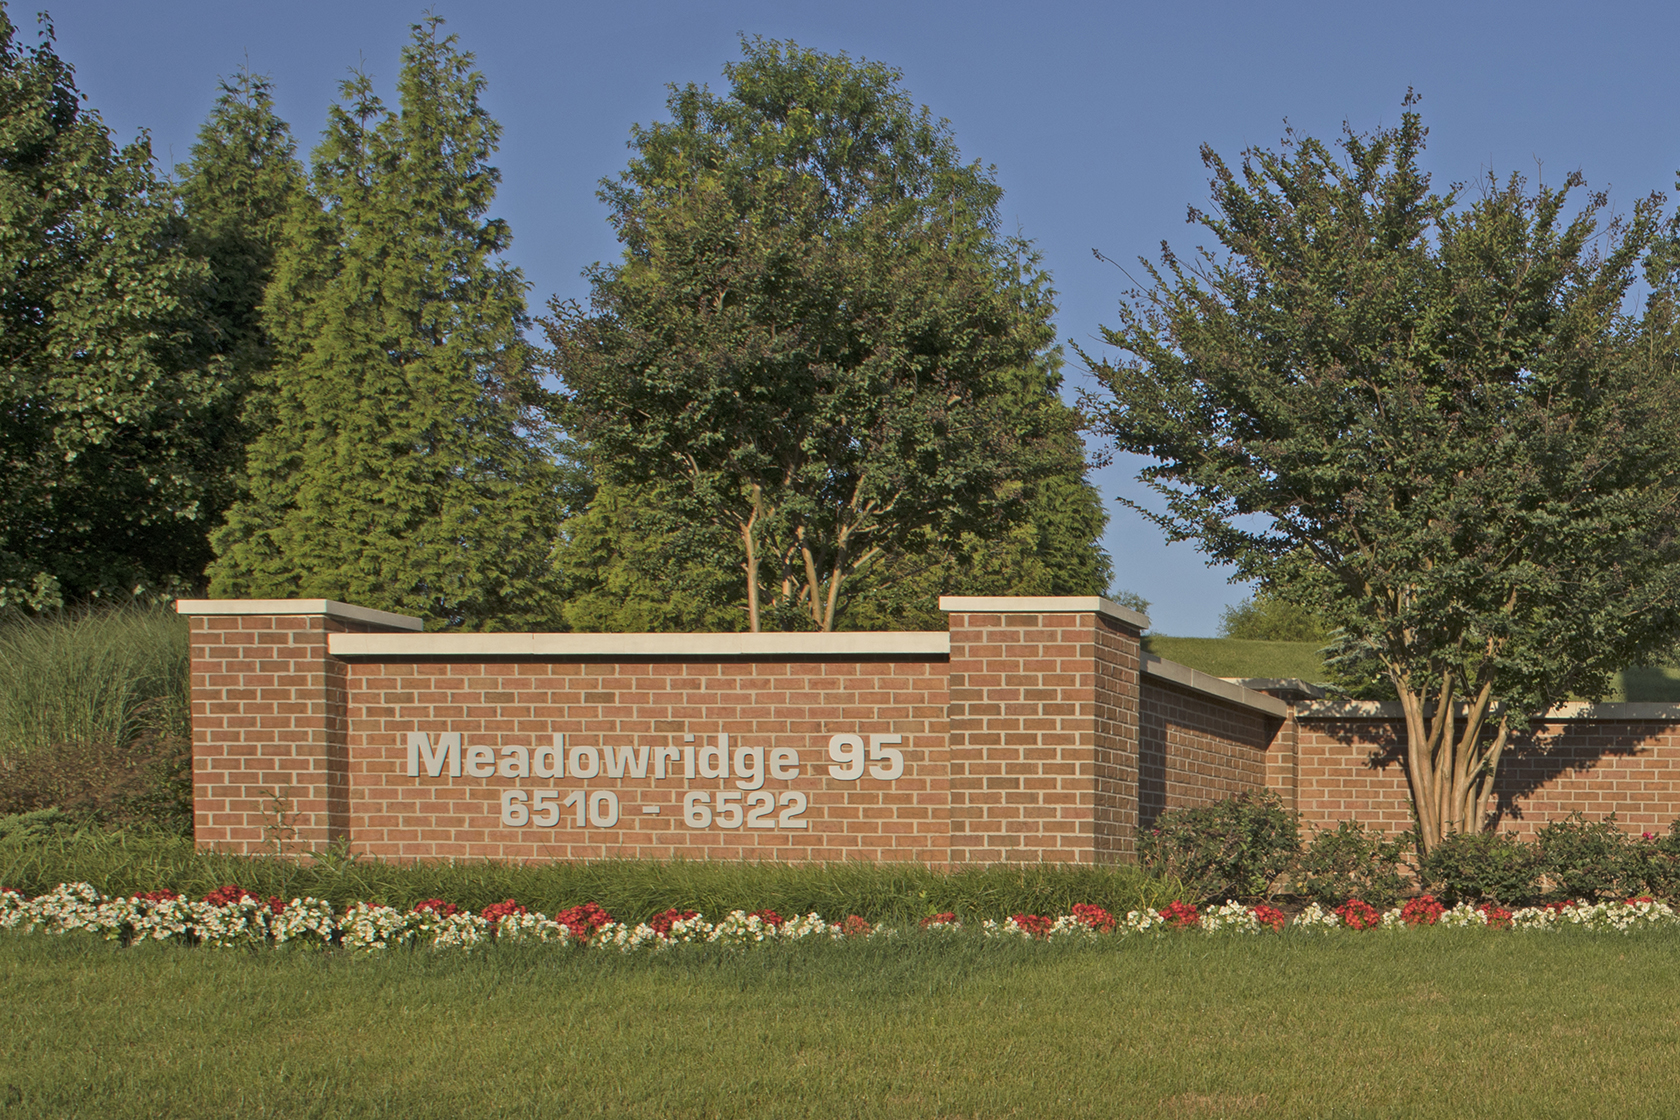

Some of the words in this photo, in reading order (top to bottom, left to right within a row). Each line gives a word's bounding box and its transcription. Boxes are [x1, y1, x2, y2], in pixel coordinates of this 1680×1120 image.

[406, 731, 801, 790] Meadowridge
[828, 734, 905, 780] 95
[501, 790, 619, 828] 6510
[643, 805, 661, 815] -
[683, 791, 809, 829] 6522
